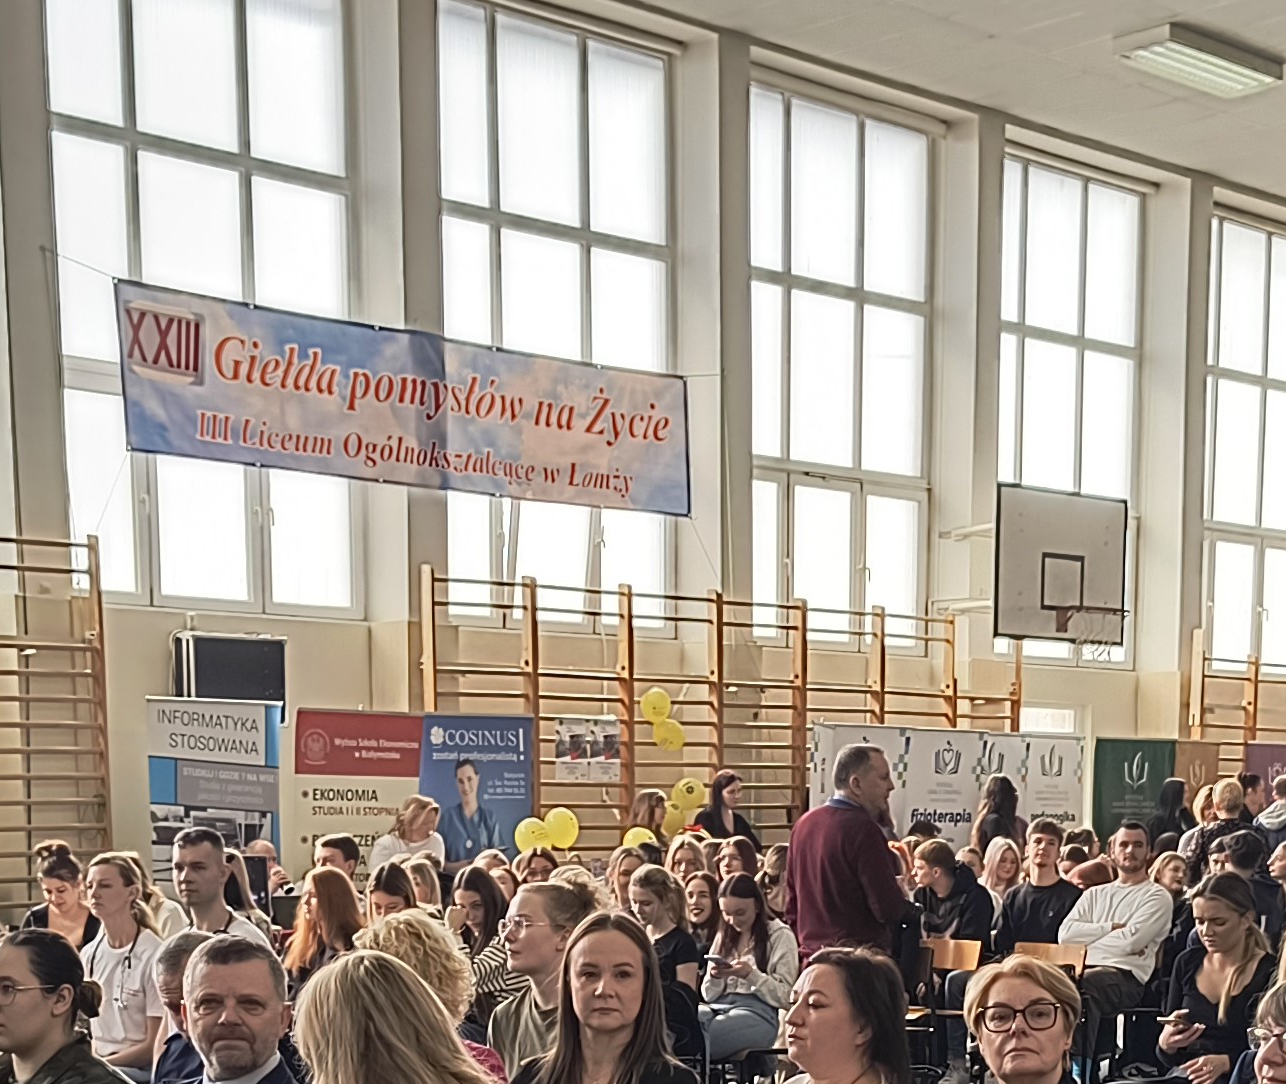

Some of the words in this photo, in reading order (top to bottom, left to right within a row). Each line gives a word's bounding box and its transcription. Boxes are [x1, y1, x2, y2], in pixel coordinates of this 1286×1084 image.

[125, 308, 201, 374] XXIII
[215, 335, 340, 397] Giełda
[346, 368, 525, 422] pomysłów
[534, 399, 575, 431] na
[584, 386, 671, 447] Życie
[196, 411, 232, 442] III
[241, 418, 334, 456] Liceum
[543, 466, 561, 484] w
[157, 708, 260, 733] INFORMATYKA
[168, 732, 260, 755] STOSOWANA
[445, 729, 517, 746] COSINUS
[312, 788, 379, 802] EKONOMIA
[312, 806, 344, 816] STUDIA
